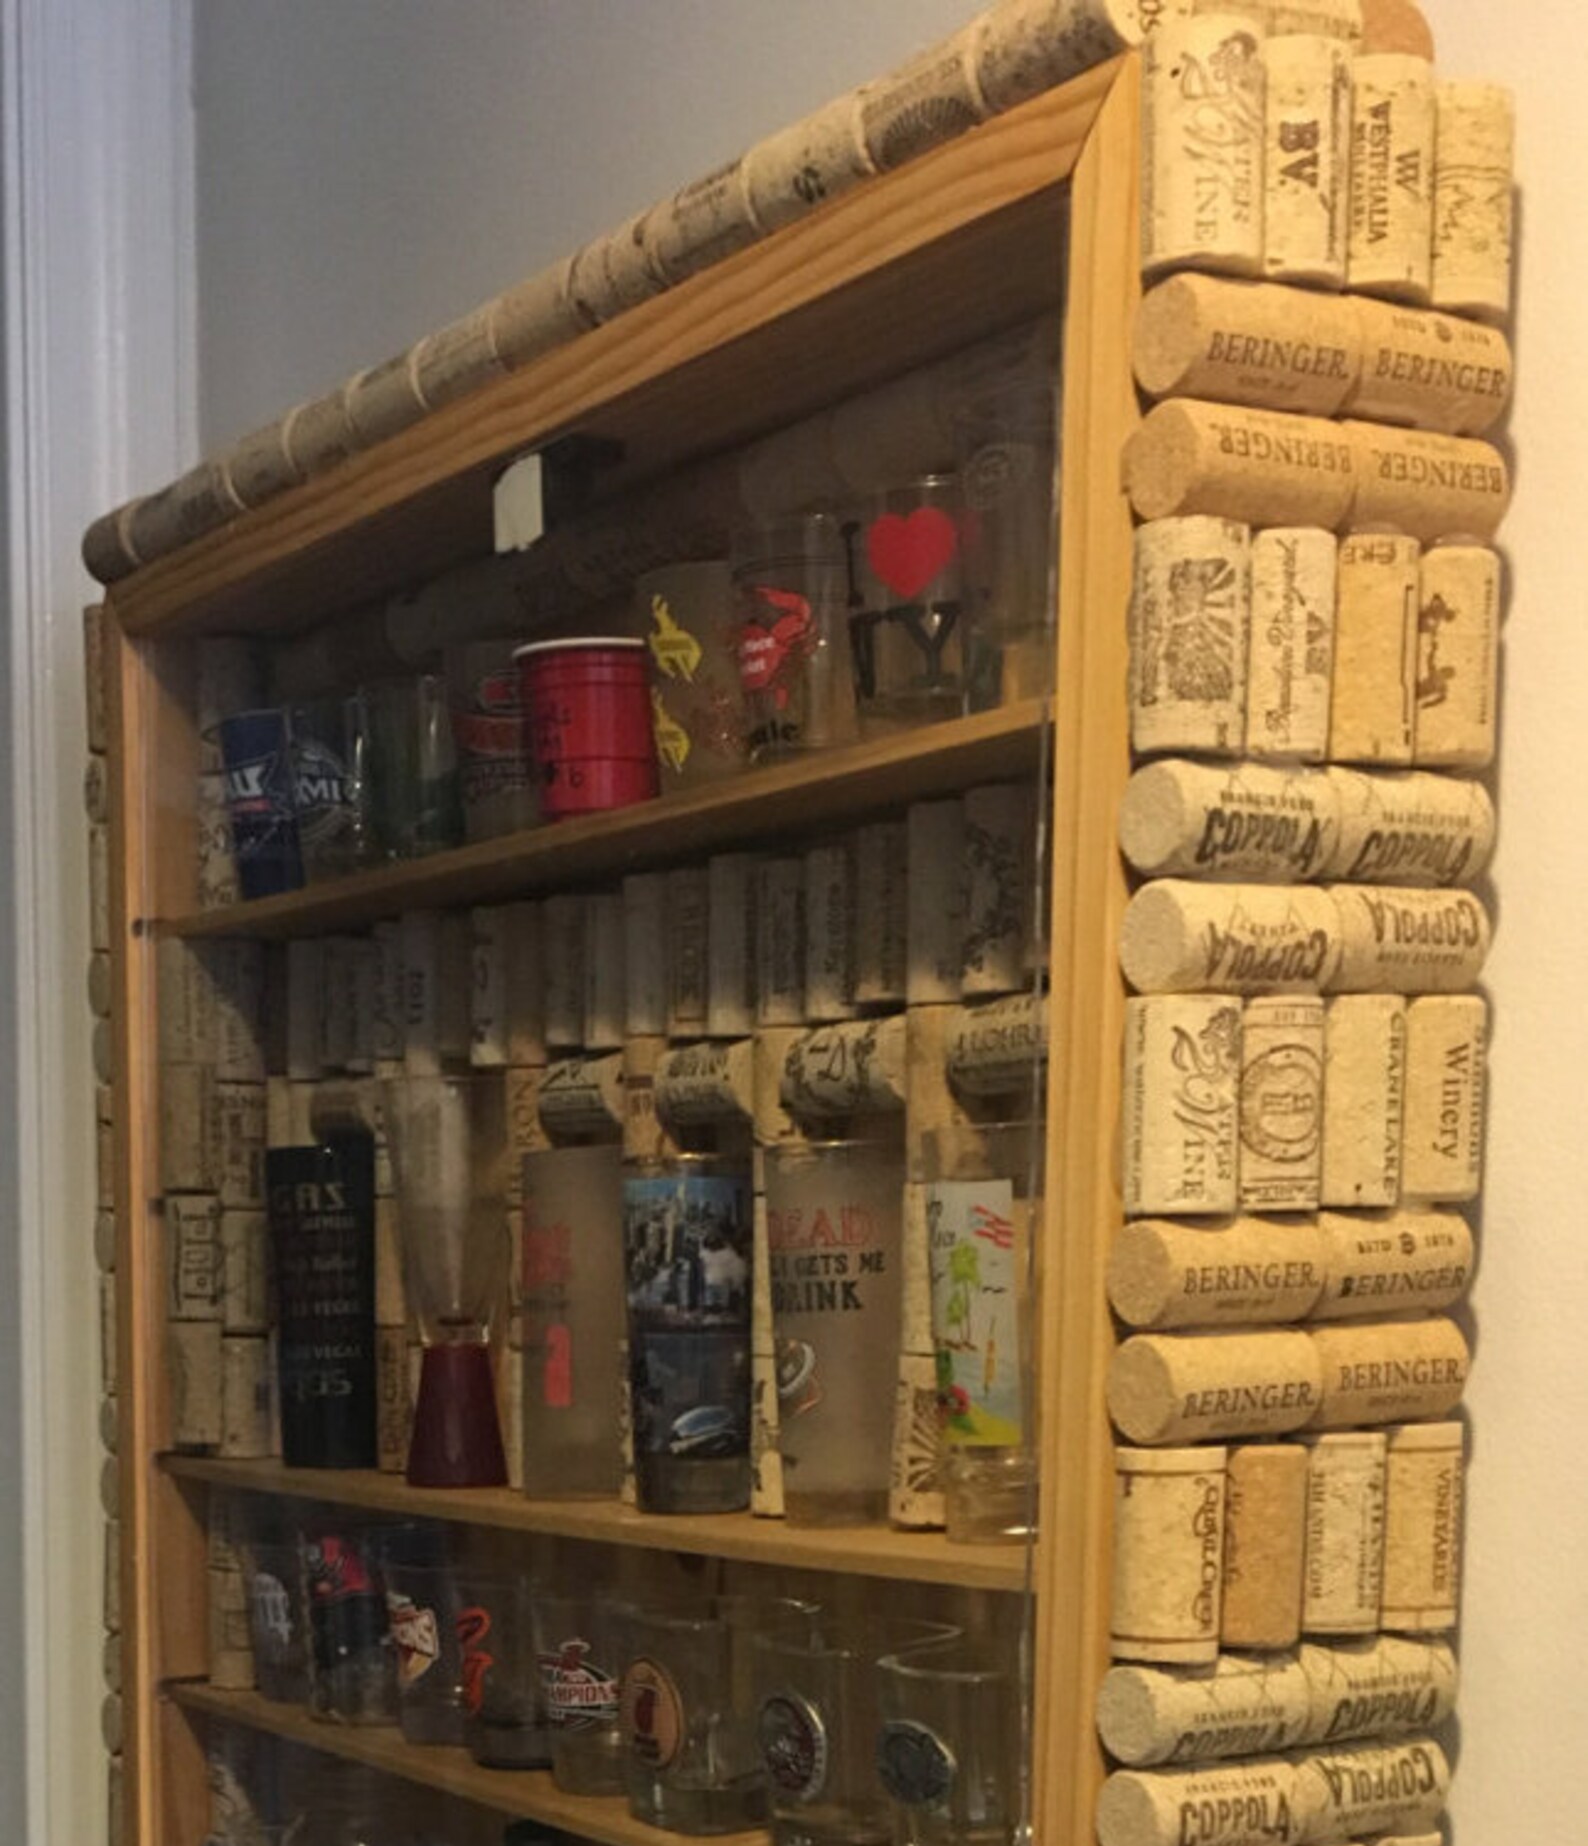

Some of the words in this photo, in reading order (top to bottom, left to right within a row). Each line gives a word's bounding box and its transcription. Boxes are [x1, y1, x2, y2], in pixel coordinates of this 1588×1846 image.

[1366, 99, 1393, 245] WESTPHALIA
[1195, 808, 1334, 874] COPPOLA
[1348, 830, 1475, 884] COPPOLA
[1361, 892, 1481, 947] COPPOLA
[1204, 922, 1328, 983] COPPOLA
[1433, 1042, 1471, 1160] Winery
[858, 1250, 887, 1275] ME
[1338, 1266, 1467, 1299] BERINGER
[1325, 1687, 1441, 1741] COPPOLA
[1317, 1746, 1438, 1806] COPPOLA
